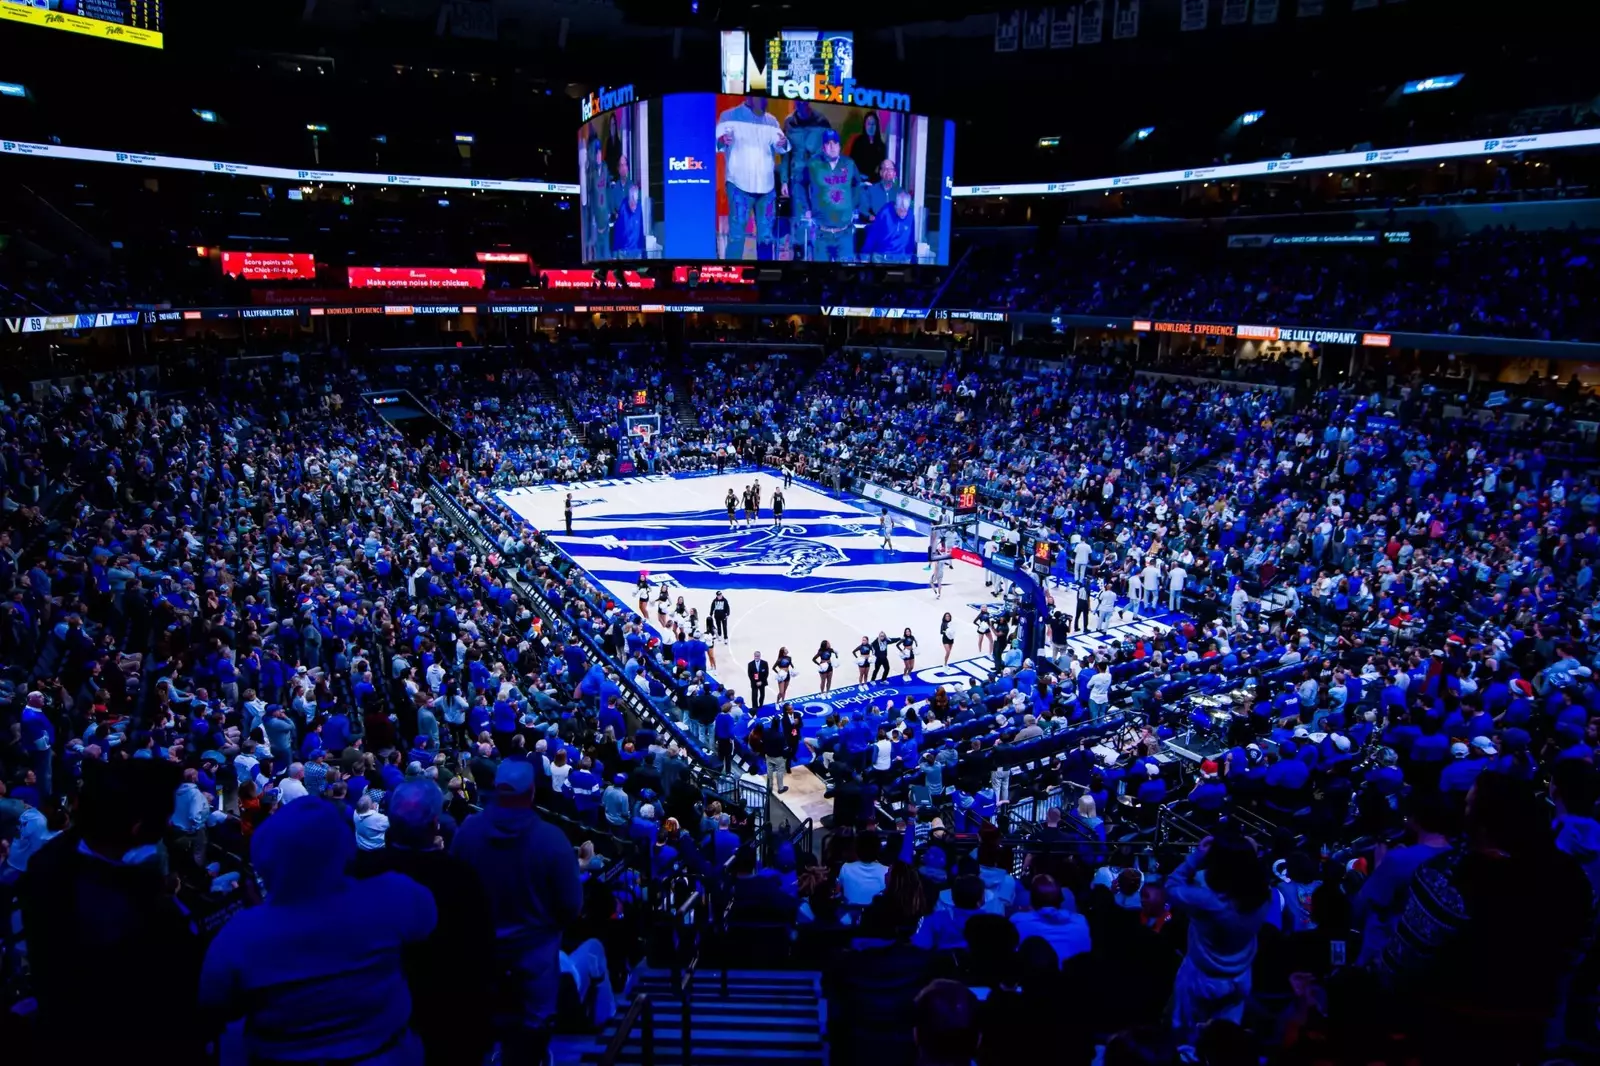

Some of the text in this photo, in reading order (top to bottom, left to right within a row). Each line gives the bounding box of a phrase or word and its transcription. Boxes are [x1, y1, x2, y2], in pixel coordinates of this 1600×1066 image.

[771, 69, 911, 112] FedExForum
[669, 156, 703, 170] FedEx
[243, 309, 294, 318] LILLYFORKLIFTS.COM
[935, 310, 948, 319] 1:15
[31, 318, 41, 330] 69
[1154, 322, 1192, 333] KNOWLEDGE.
[1194, 325, 1235, 336] EXPERIENCE.
[1278, 328, 1292, 340] THE
[1293, 330, 1315, 341] LILLY
[1315, 332, 1357, 344] COMPANY.
[636, 396, 646, 404] 30
[493, 474, 677, 497] MEMPHIS
[960, 494, 974, 508] 30
[831, 688, 899, 709] Campbell
